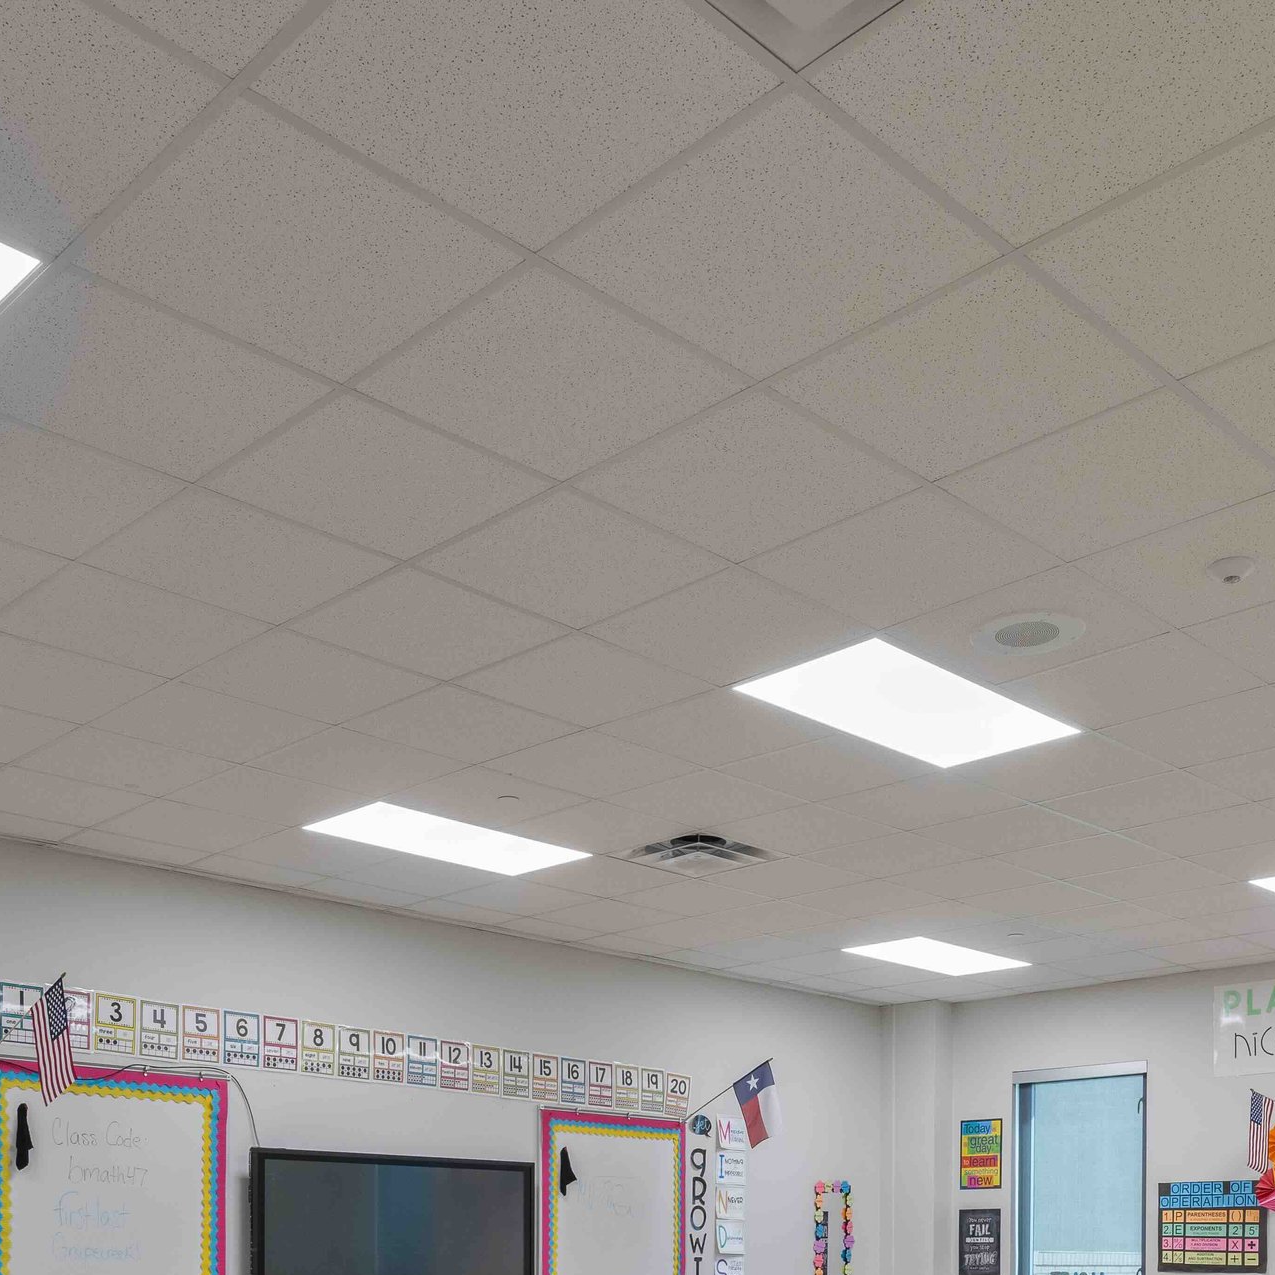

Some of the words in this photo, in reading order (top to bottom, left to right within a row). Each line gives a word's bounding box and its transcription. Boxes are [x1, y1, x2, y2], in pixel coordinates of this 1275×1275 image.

[19, 990, 24, 1009] 1
[110, 1002, 123, 1022] 3
[153, 1008, 166, 1028] 4
[195, 1013, 208, 1033] 5
[236, 1018, 248, 1037] 6
[276, 1023, 286, 1042] 7
[313, 1028, 324, 1047] 8
[349, 1033, 360, 1052] 9
[381, 1036, 396, 1055] 10
[419, 1042, 426, 1056] 11
[448, 1047, 461, 1065] 12
[480, 1052, 492, 1069] 13
[510, 1056, 522, 1073] 14
[540, 1059, 552, 1076] 15
[568, 1064, 579, 1080] 16
[595, 1066, 606, 1082] 17
[622, 1069, 632, 1086] 18
[647, 1073, 658, 1088] 19
[670, 1079, 686, 1095] 20
[52, 1117, 98, 1146] Class
[964, 1124, 991, 1134] Today
[970, 1134, 998, 1148] great
[976, 1144, 991, 1154] day
[970, 1156, 995, 1167] learn
[970, 1175, 992, 1185] new
[1172, 1183, 1222, 1194] ORDER
[1231, 1182, 1251, 1192] OF
[1161, 1195, 1256, 1207] OPERATION
[1176, 1212, 1182, 1221] P
[970, 1224, 990, 1236] FAIL
[1163, 1226, 1171, 1234] 2.
[1175, 1225, 1182, 1234] E
[1164, 1239, 1171, 1247] 3.
[964, 1251, 997, 1265] TRYING
[1163, 1253, 1171, 1261] 4.
